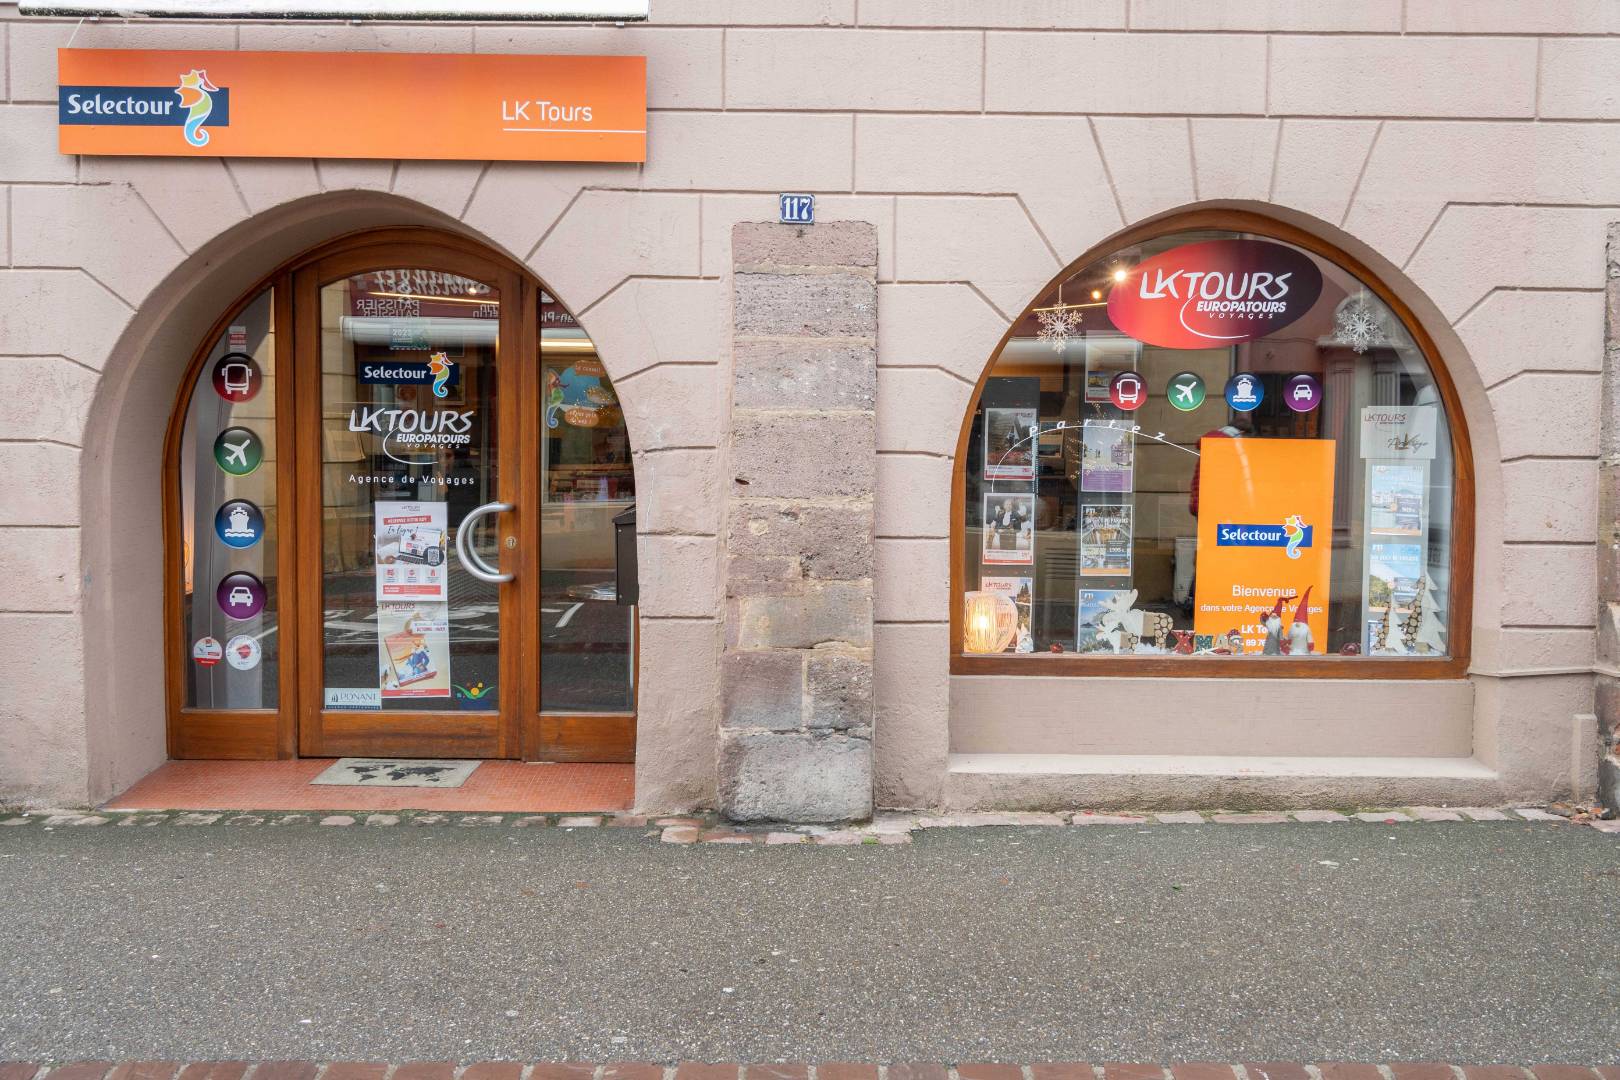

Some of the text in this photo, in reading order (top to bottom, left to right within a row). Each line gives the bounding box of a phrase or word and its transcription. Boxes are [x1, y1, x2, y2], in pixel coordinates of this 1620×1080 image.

[67, 93, 174, 115] Selectour
[502, 100, 593, 122] LK Tours
[783, 197, 811, 220] 117
[1196, 301, 1287, 313] EUROPATOURS
[364, 365, 427, 379] Selectour
[396, 433, 471, 444] EUROPATOURS
[349, 474, 475, 486] Agence de Voyages
[1221, 528, 1282, 541] Selectour
[1232, 584, 1297, 597] Bienvenue
[1200, 603, 1220, 612] dans
[1221, 604, 1243, 612] votre
[1241, 624, 1254, 634] LK
